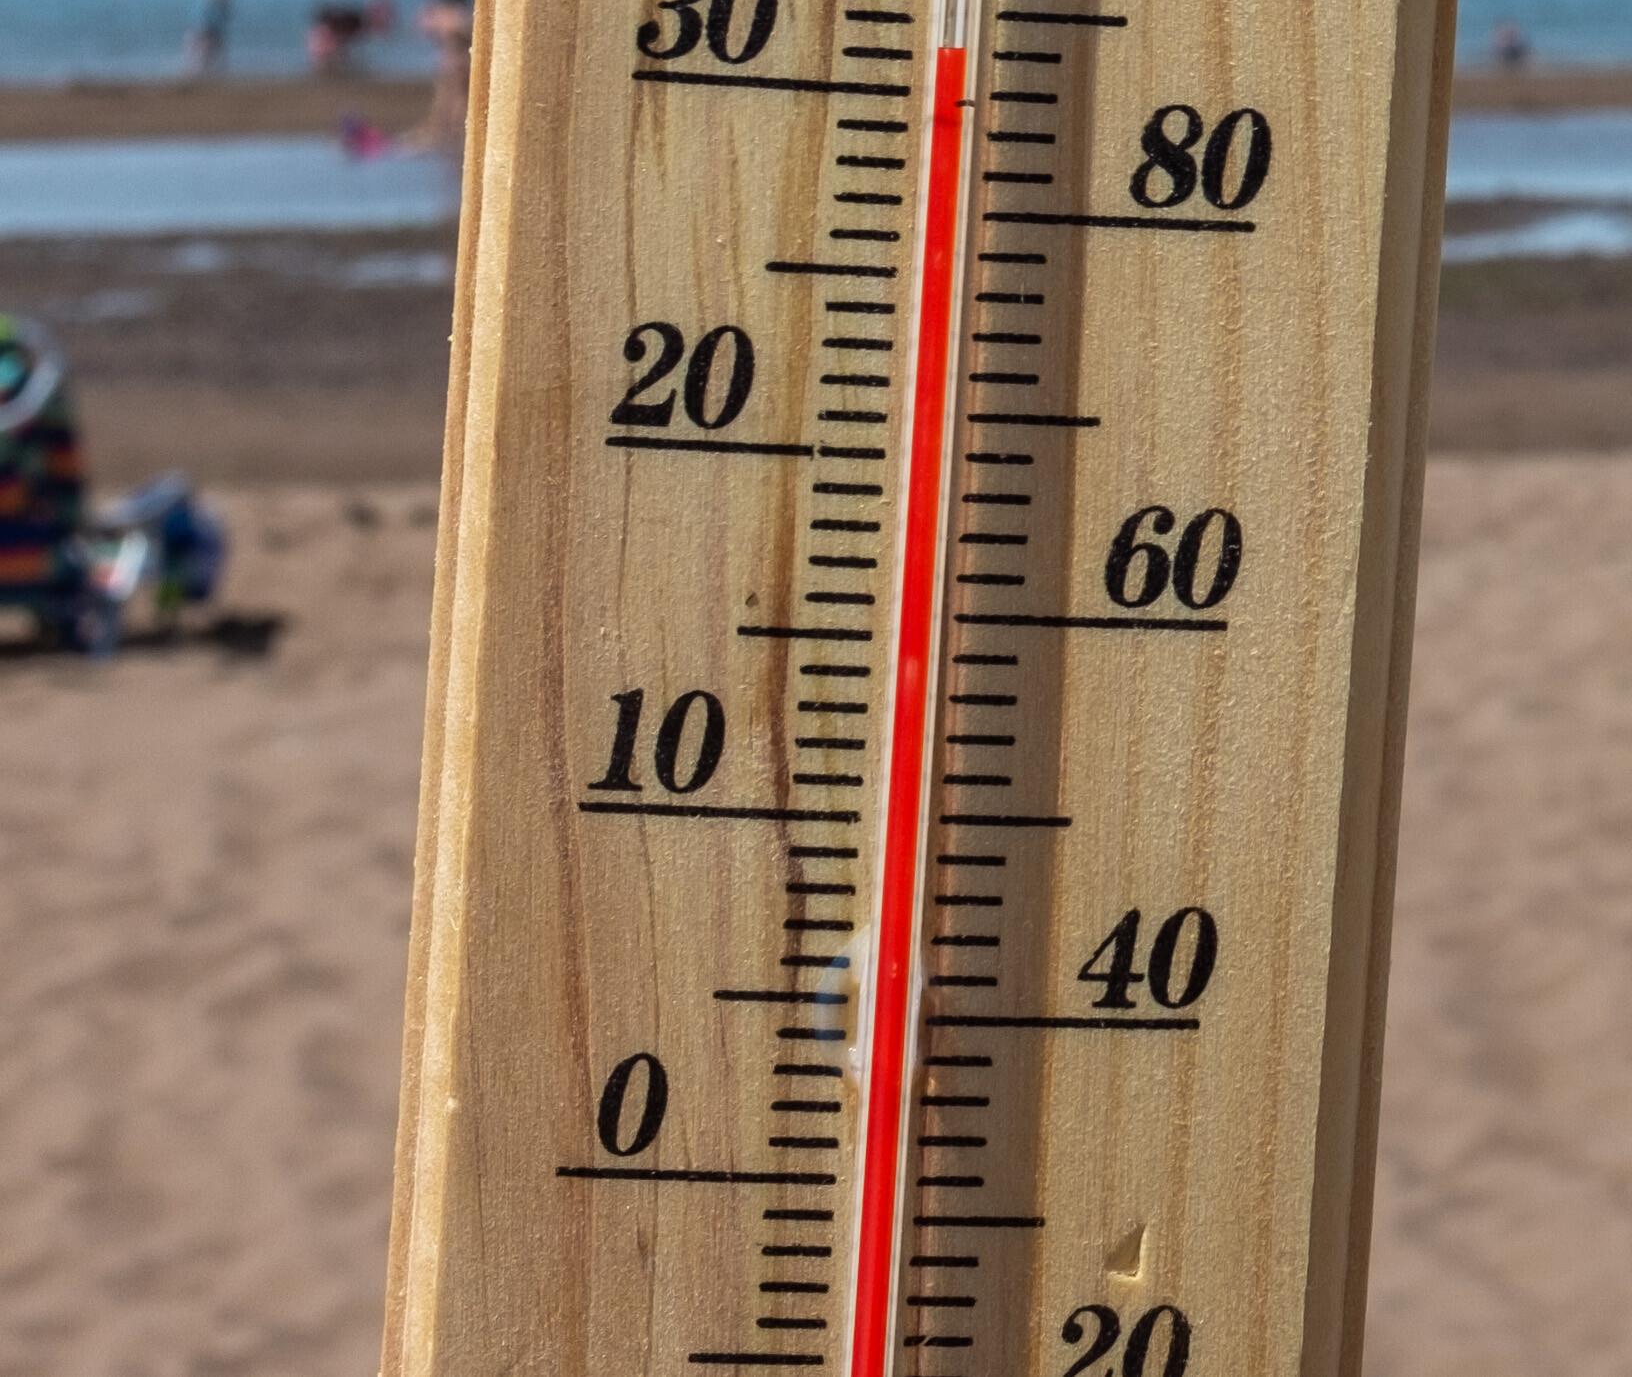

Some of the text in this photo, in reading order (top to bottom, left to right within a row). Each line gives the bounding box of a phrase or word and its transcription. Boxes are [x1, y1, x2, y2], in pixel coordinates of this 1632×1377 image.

[1128, 104, 1273, 211] 80
[608, 321, 756, 431] 20
[1103, 504, 1243, 611] 60
[586, 687, 726, 795] 10
[1076, 906, 1219, 1011] 40
[596, 1051, 669, 1158] 0
[1061, 1303, 1194, 1377] 20
